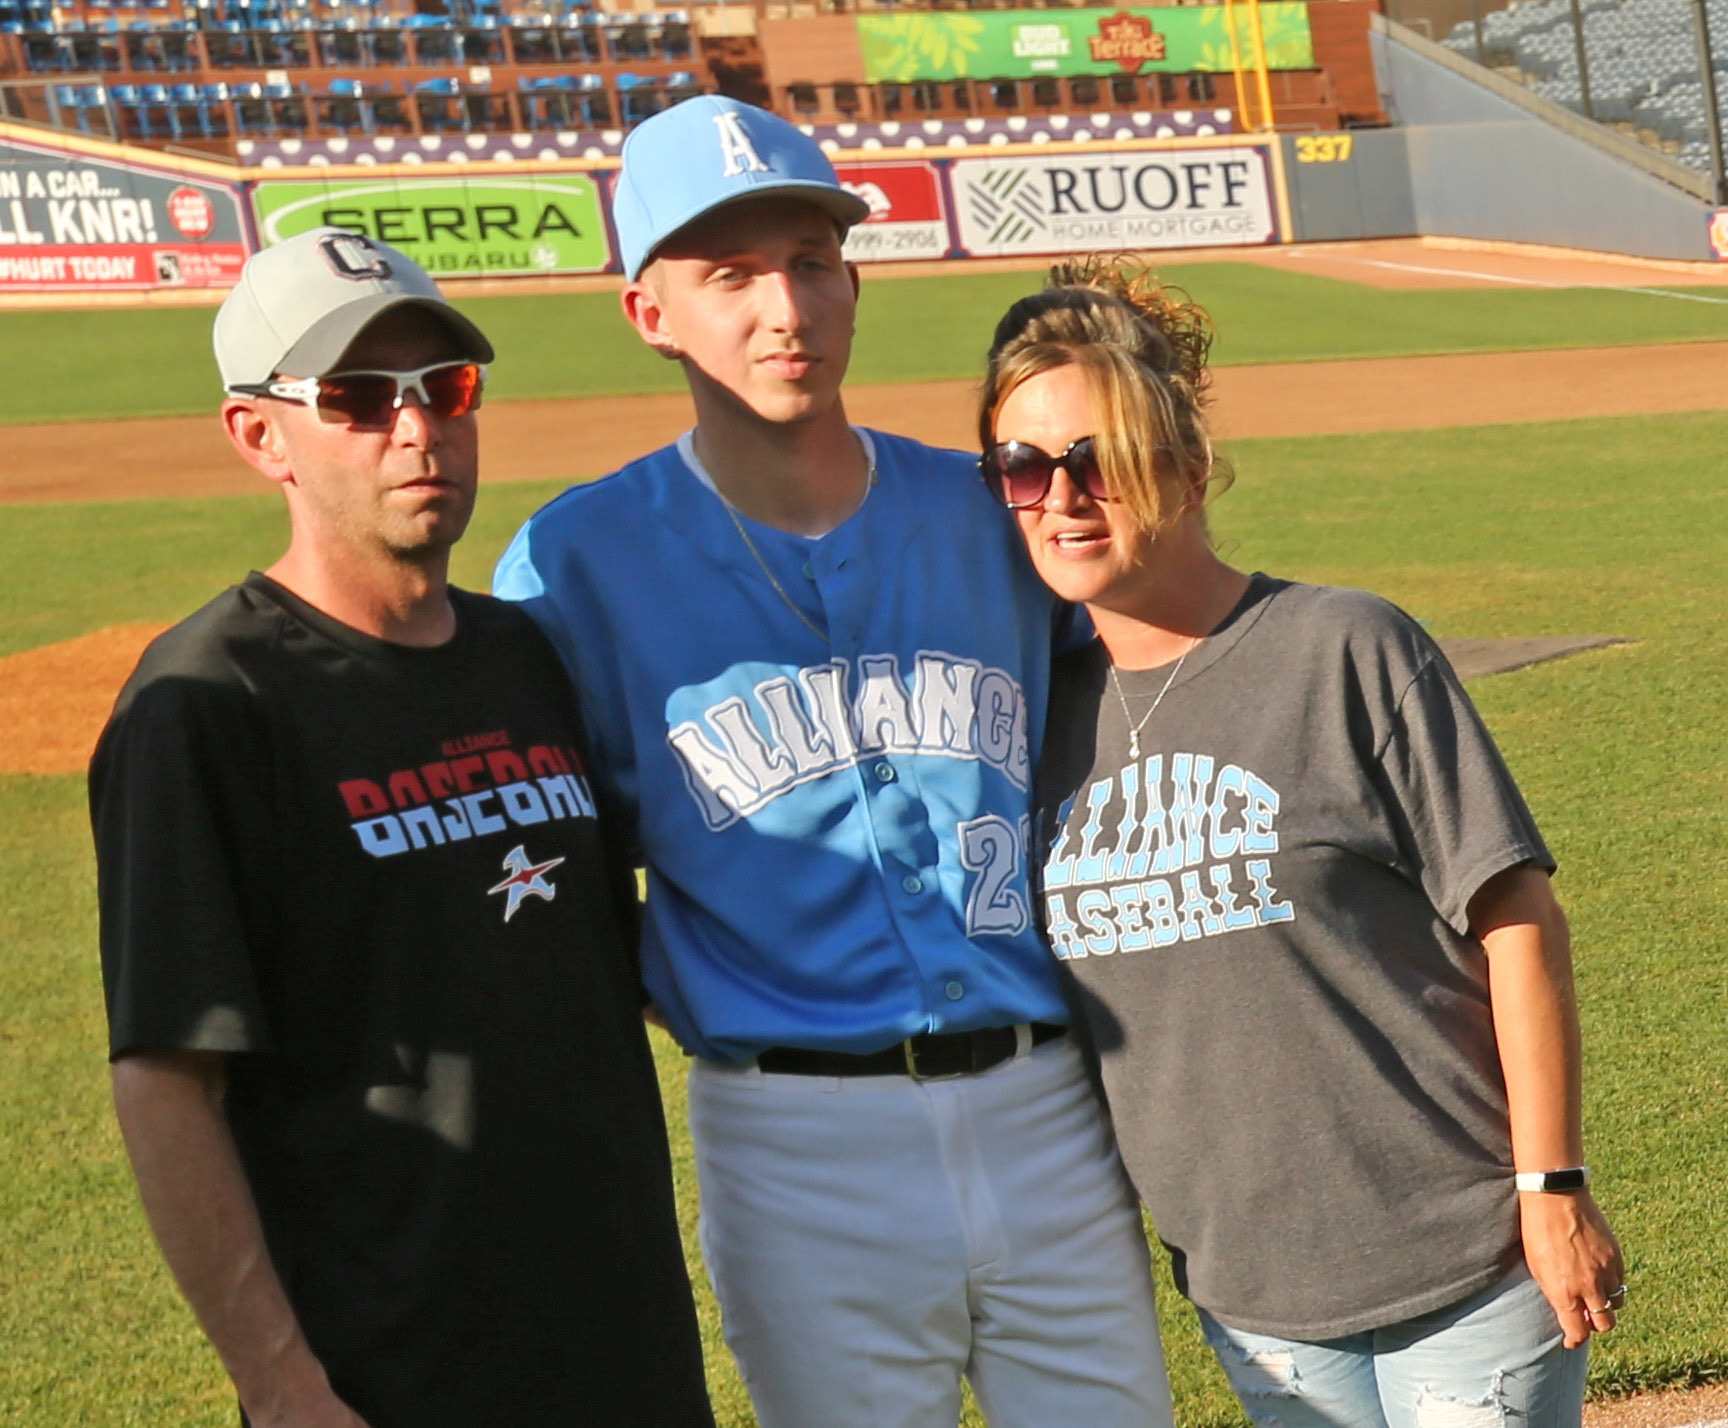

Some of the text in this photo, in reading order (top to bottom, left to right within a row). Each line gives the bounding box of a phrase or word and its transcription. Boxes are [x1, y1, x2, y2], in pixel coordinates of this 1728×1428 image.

[712, 111, 769, 178] A
[1295, 135, 1353, 163] 337
[26, 170, 47, 199] A
[1044, 161, 1249, 214] RUOFF
[48, 198, 158, 244] KNR!
[323, 204, 582, 243] SERRA
[1052, 213, 1256, 241] HOME MORTGAGE
[68, 256, 136, 281] TODAY
[314, 232, 393, 281] C
[415, 250, 530, 270] UBARU
